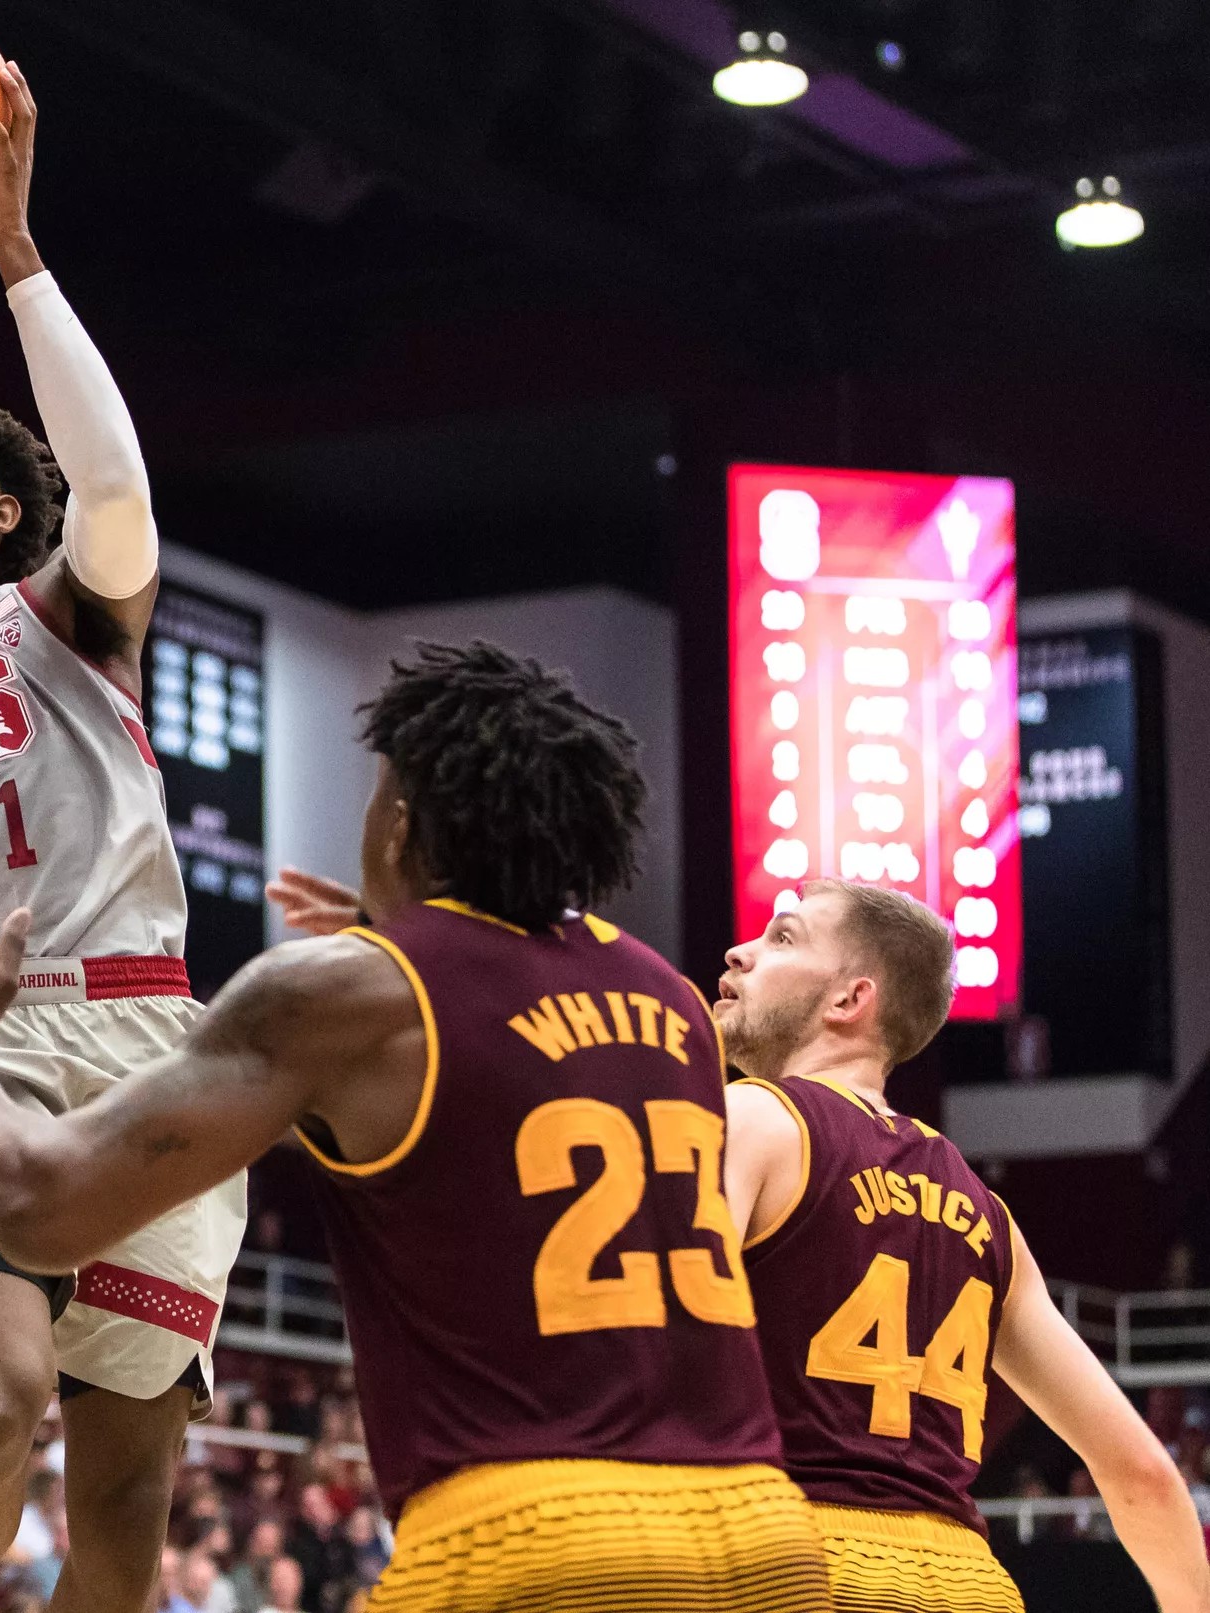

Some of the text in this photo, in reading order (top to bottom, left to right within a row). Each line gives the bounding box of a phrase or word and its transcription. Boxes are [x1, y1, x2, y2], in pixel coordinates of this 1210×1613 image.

[4, 631, 19, 645] 12
[19, 972, 79, 989] ARDINAL
[506, 991, 690, 1066] WHITE
[514, 1097, 758, 1337] 23
[848, 1165, 994, 1260] JUSTICE
[805, 1252, 994, 1466] 44
